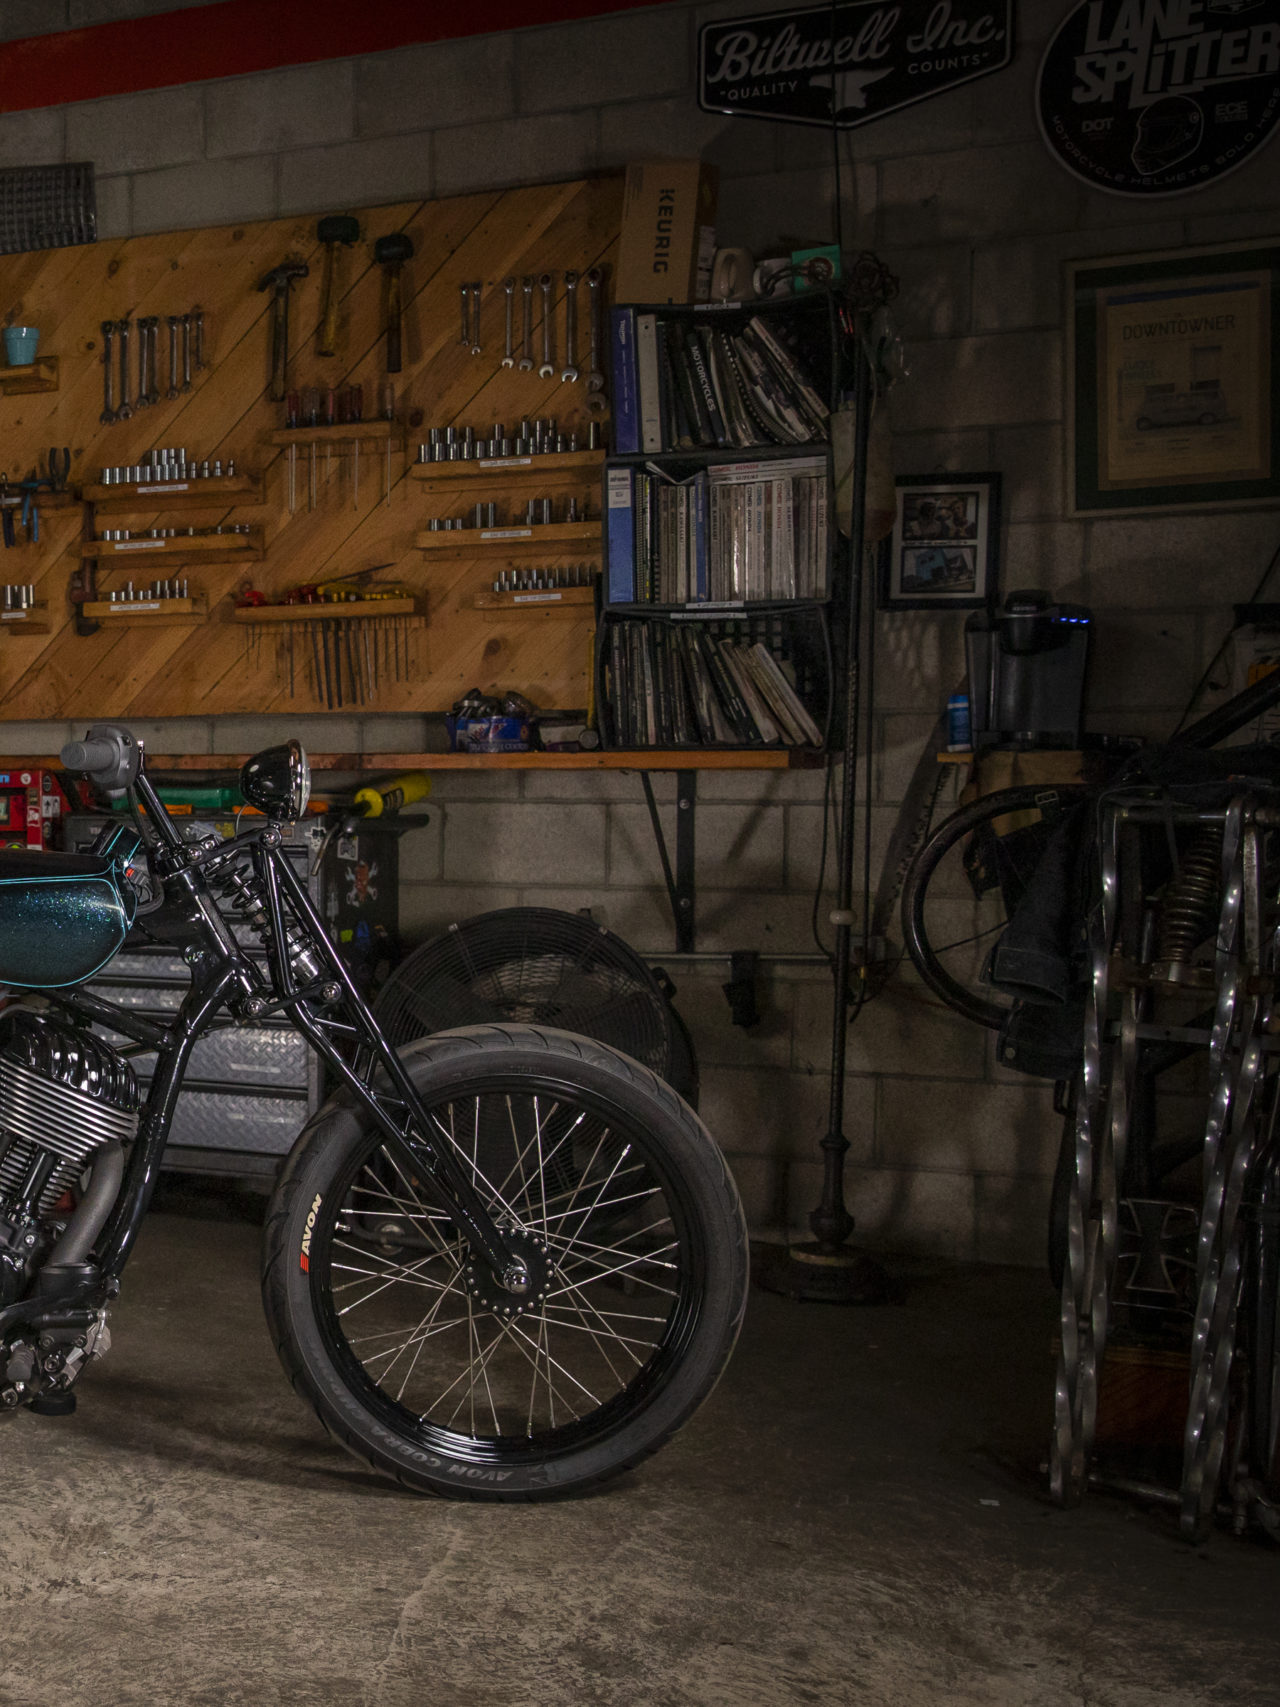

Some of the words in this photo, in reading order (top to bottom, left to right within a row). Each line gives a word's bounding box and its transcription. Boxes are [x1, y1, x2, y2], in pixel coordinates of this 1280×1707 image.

[707, 5, 901, 84] Biltwell
[906, 1, 1005, 53] Inc.
[1084, 0, 1204, 53] LANE
[1071, 23, 1280, 110] SPLITTER
[1081, 117, 1114, 133] DOT
[653, 188, 676, 274] KEURIG
[1123, 314, 1236, 341] DOWNTOWNER
[690, 345, 717, 412] MOTORCYCLES
[301, 1193, 322, 1256] AVON
[371, 1426, 442, 1468] COBRA
[447, 1463, 514, 1482] AVON
